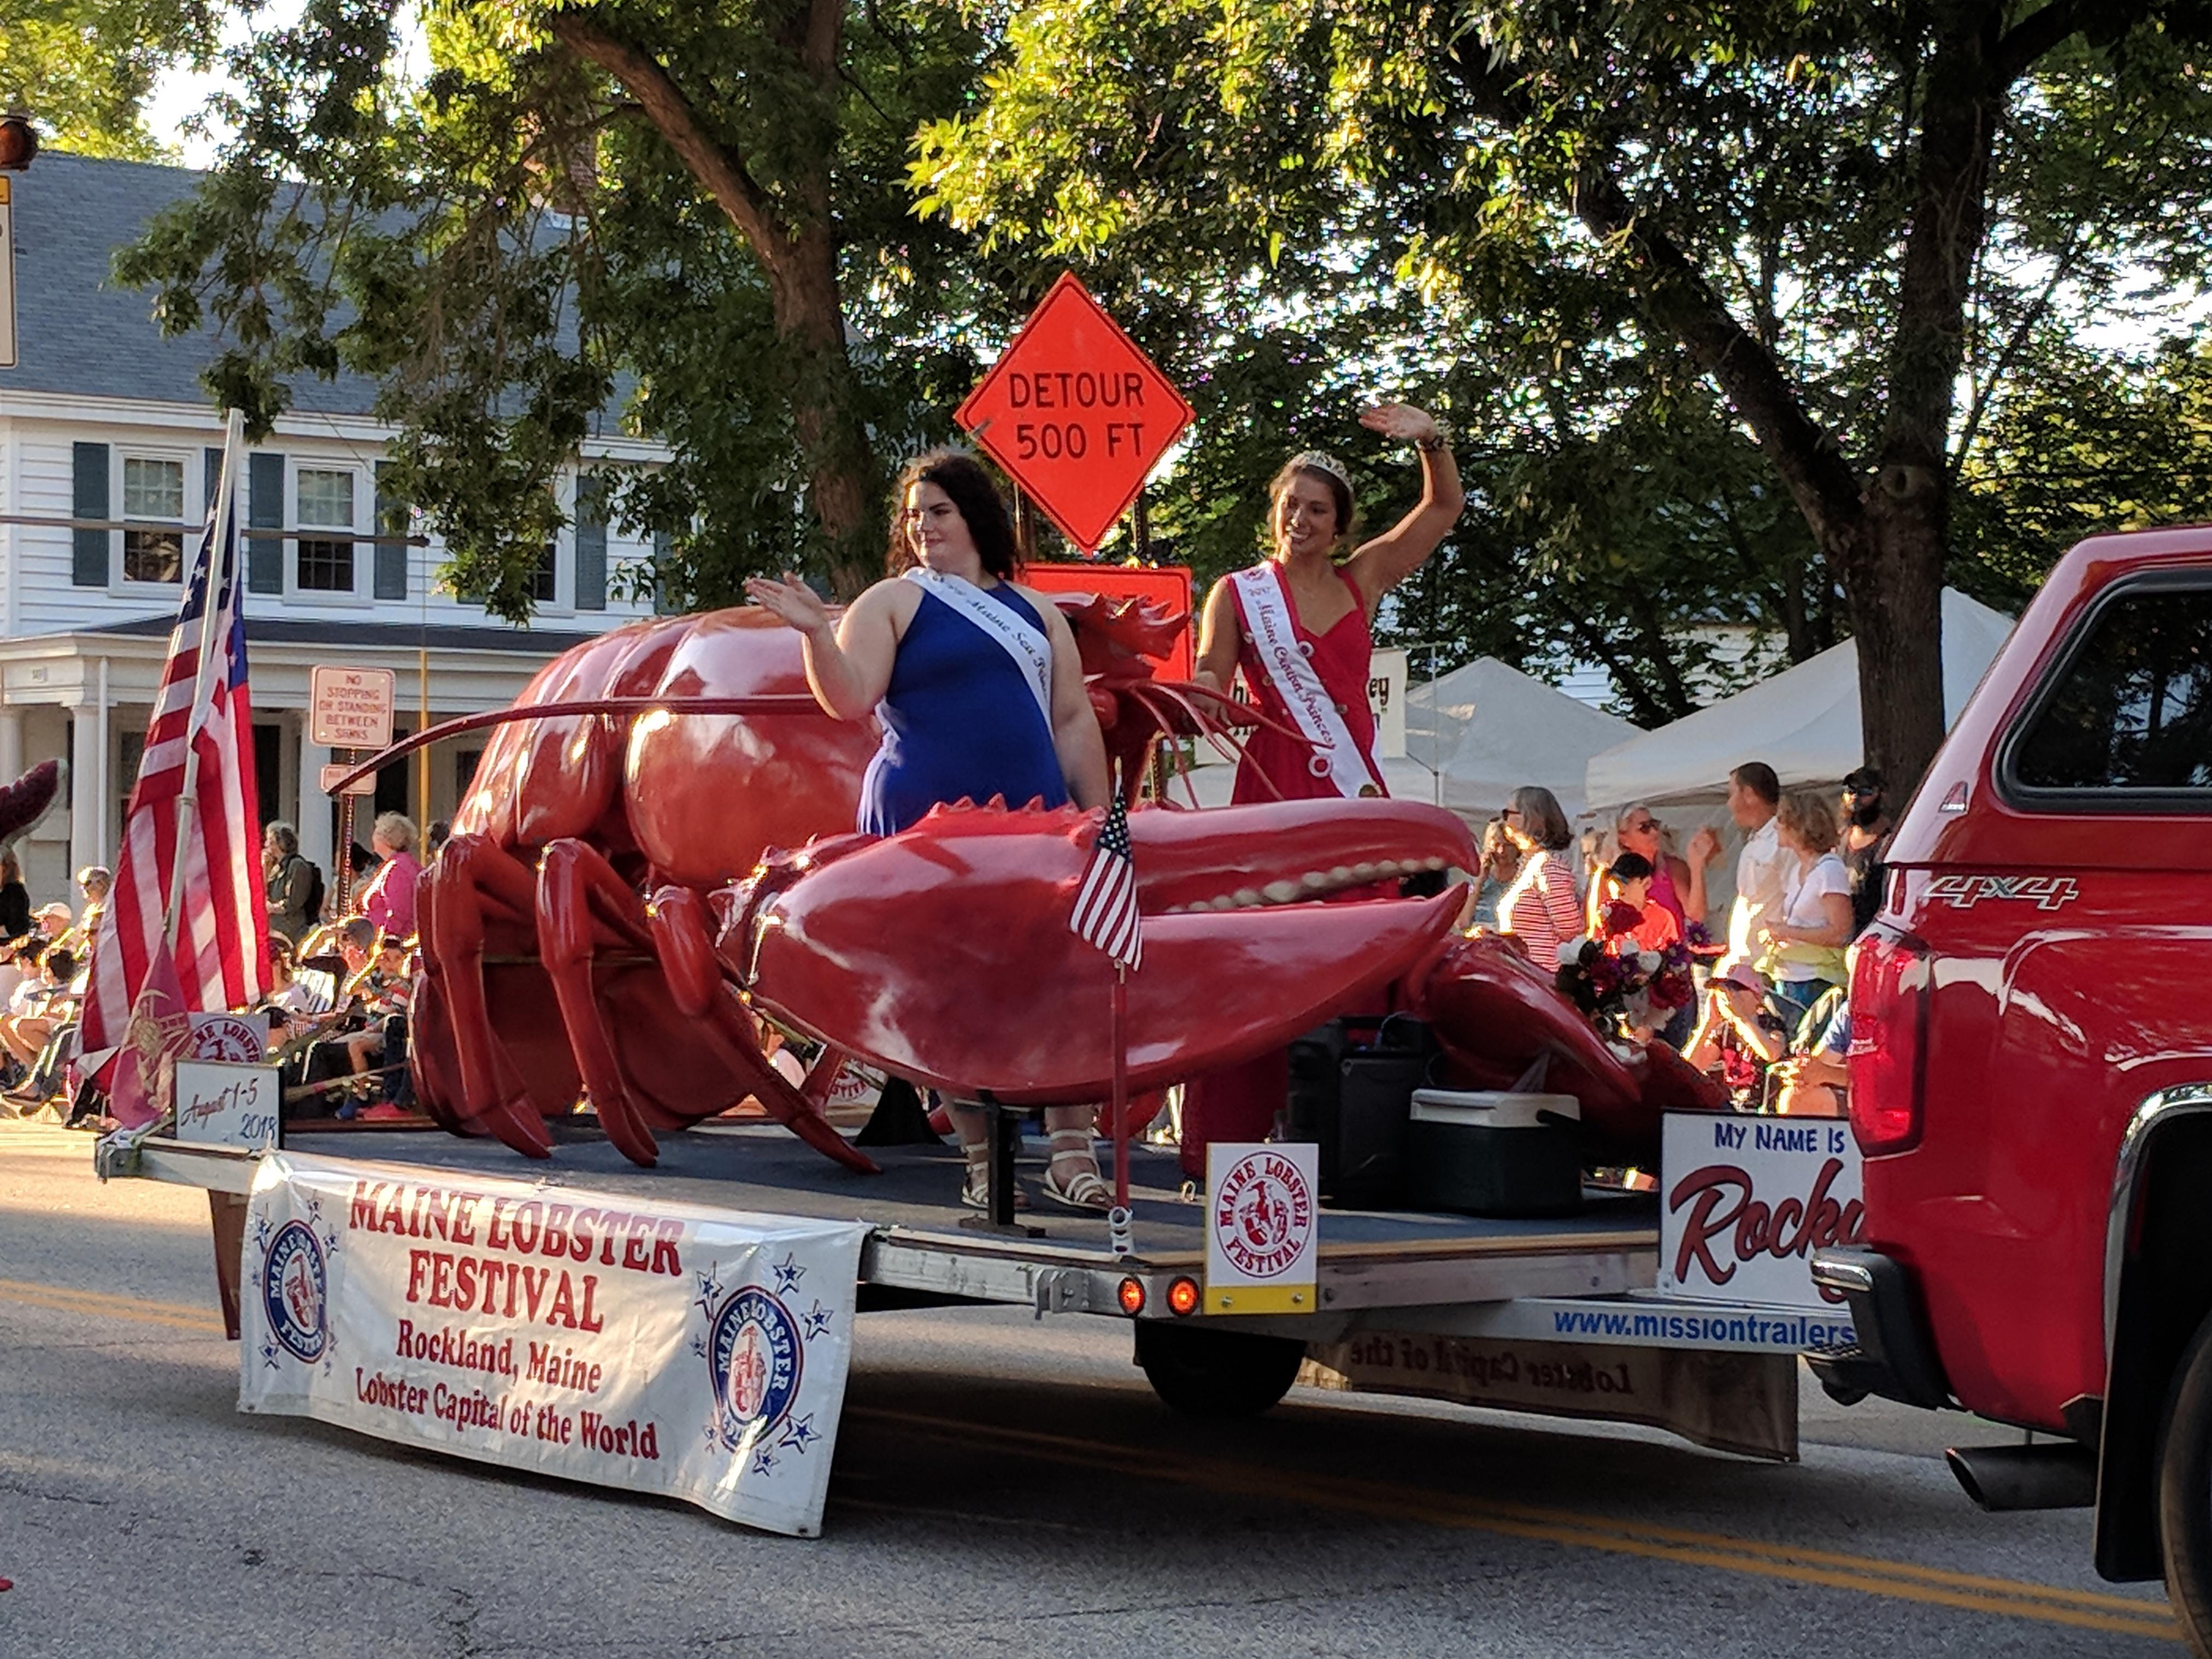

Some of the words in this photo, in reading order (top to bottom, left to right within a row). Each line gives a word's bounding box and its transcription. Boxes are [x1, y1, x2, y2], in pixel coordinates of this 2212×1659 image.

[1009, 372, 1145, 408] DETOUR
[1016, 423, 1087, 460] 500
[1107, 422, 1145, 457] FT
[967, 599, 1010, 632] Maine
[1011, 632, 1036, 655] Sea
[327, 686, 380, 700] STOPPING
[346, 675, 362, 685] NO
[319, 700, 333, 710] OR
[338, 701, 387, 714] STANDING
[326, 714, 378, 727] BETWEEN
[1298, 692, 1333, 744] Princes
[181, 1087, 232, 1129] August
[239, 1113, 278, 1141] 2018
[1714, 1122, 1748, 1150] MY
[1755, 1124, 1818, 1154] NAME
[1828, 1127, 1845, 1154] IS
[1219, 1161, 1257, 1227] MAINE
[1264, 1157, 1308, 1228] LOBSTER
[349, 1180, 484, 1245] MAINE
[487, 1197, 685, 1277] LOBSTER
[270, 1233, 297, 1298] MAINE
[1226, 1236, 1301, 1273] FESTIVAL
[406, 1248, 604, 1334] FESTIVAL
[396, 1319, 519, 1383] Rockland,
[525, 1342, 602, 1393] Maine
[717, 1302, 751, 1373] MAINE
[751, 1299, 792, 1391] LOBSTER
[355, 1367, 428, 1414] Lobster
[433, 1383, 507, 1432] Capital
[510, 1404, 531, 1437] of
[536, 1405, 571, 1444] the
[581, 1410, 660, 1460] World
